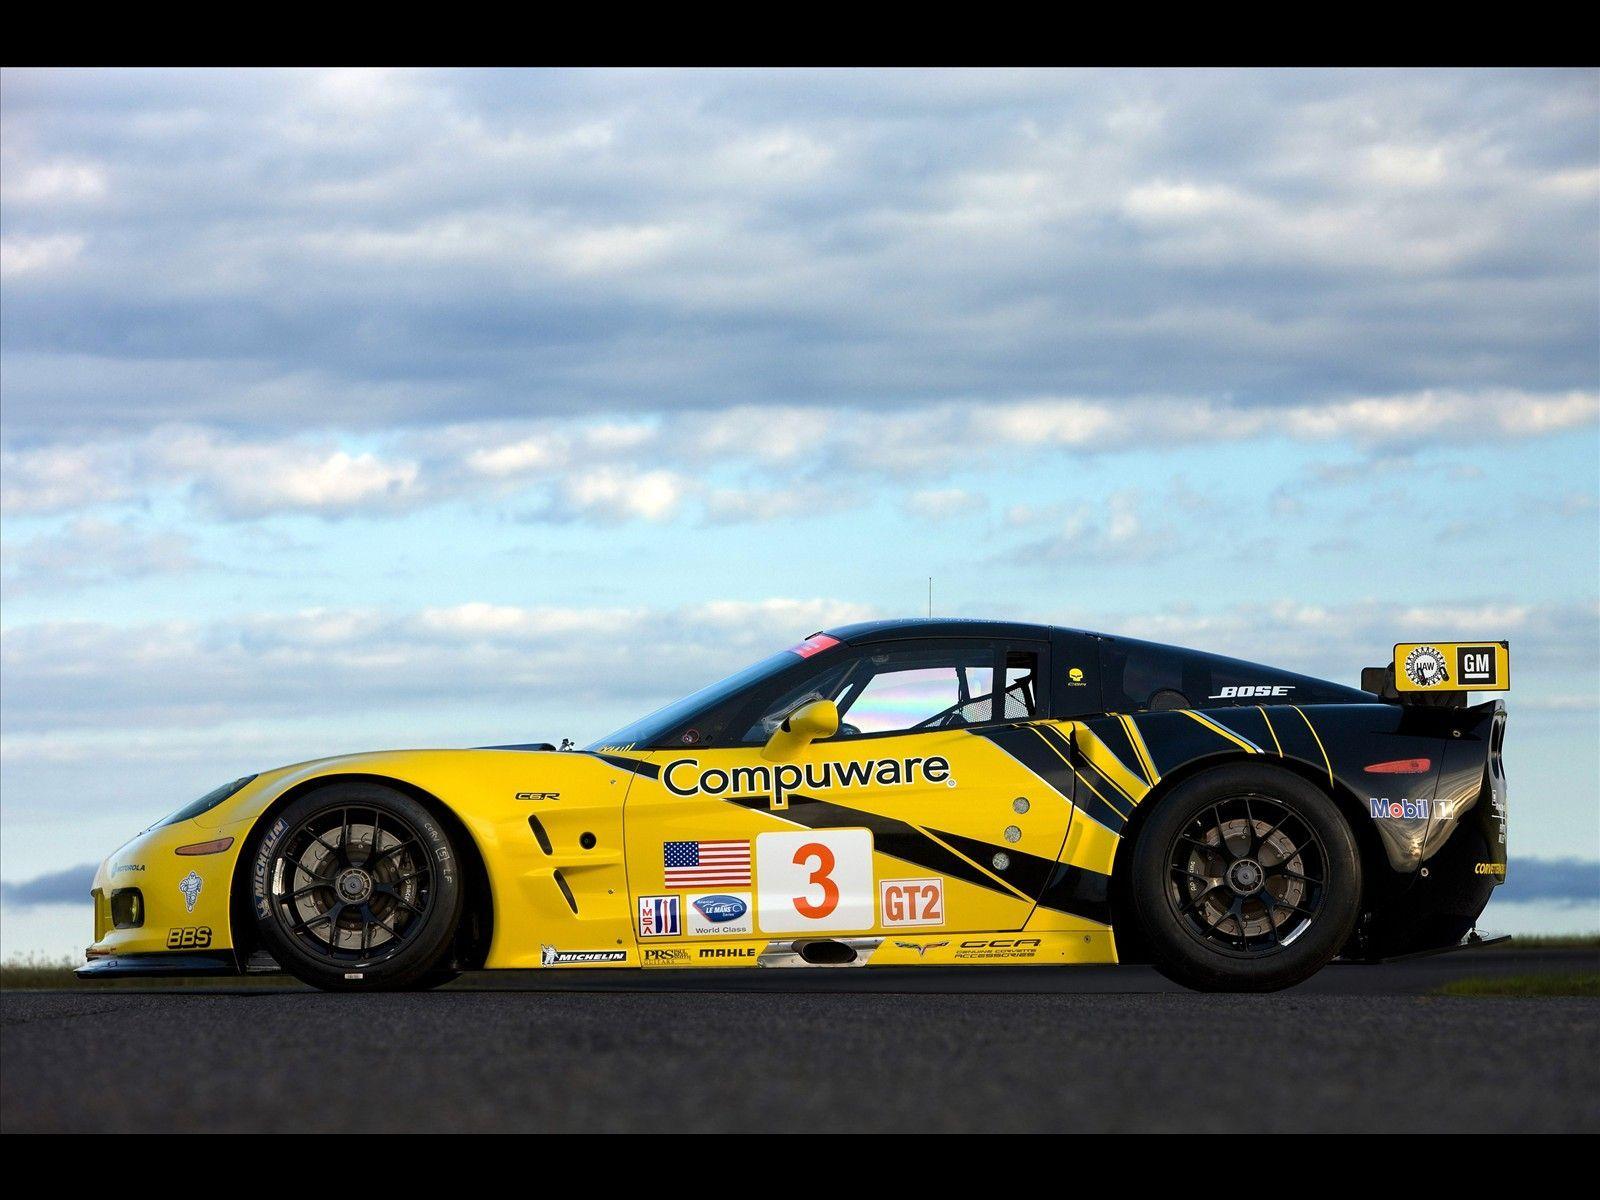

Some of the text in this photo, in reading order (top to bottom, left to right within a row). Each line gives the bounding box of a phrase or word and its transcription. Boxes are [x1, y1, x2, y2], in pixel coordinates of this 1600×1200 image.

[1464, 653, 1490, 672] GM
[1208, 686, 1296, 699] BOSE
[662, 755, 950, 806] Compuware
[1369, 798, 1429, 819] Mobil
[254, 819, 286, 898] MICHELIN
[792, 842, 840, 919] 3
[705, 906, 713, 914] LE
[884, 884, 941, 922] GT2
[166, 926, 212, 949] BBS
[960, 938, 1042, 948] GCA
[558, 952, 625, 961] MICHELIN
[644, 949, 674, 960] PRS
[699, 948, 756, 958] MAHLE
